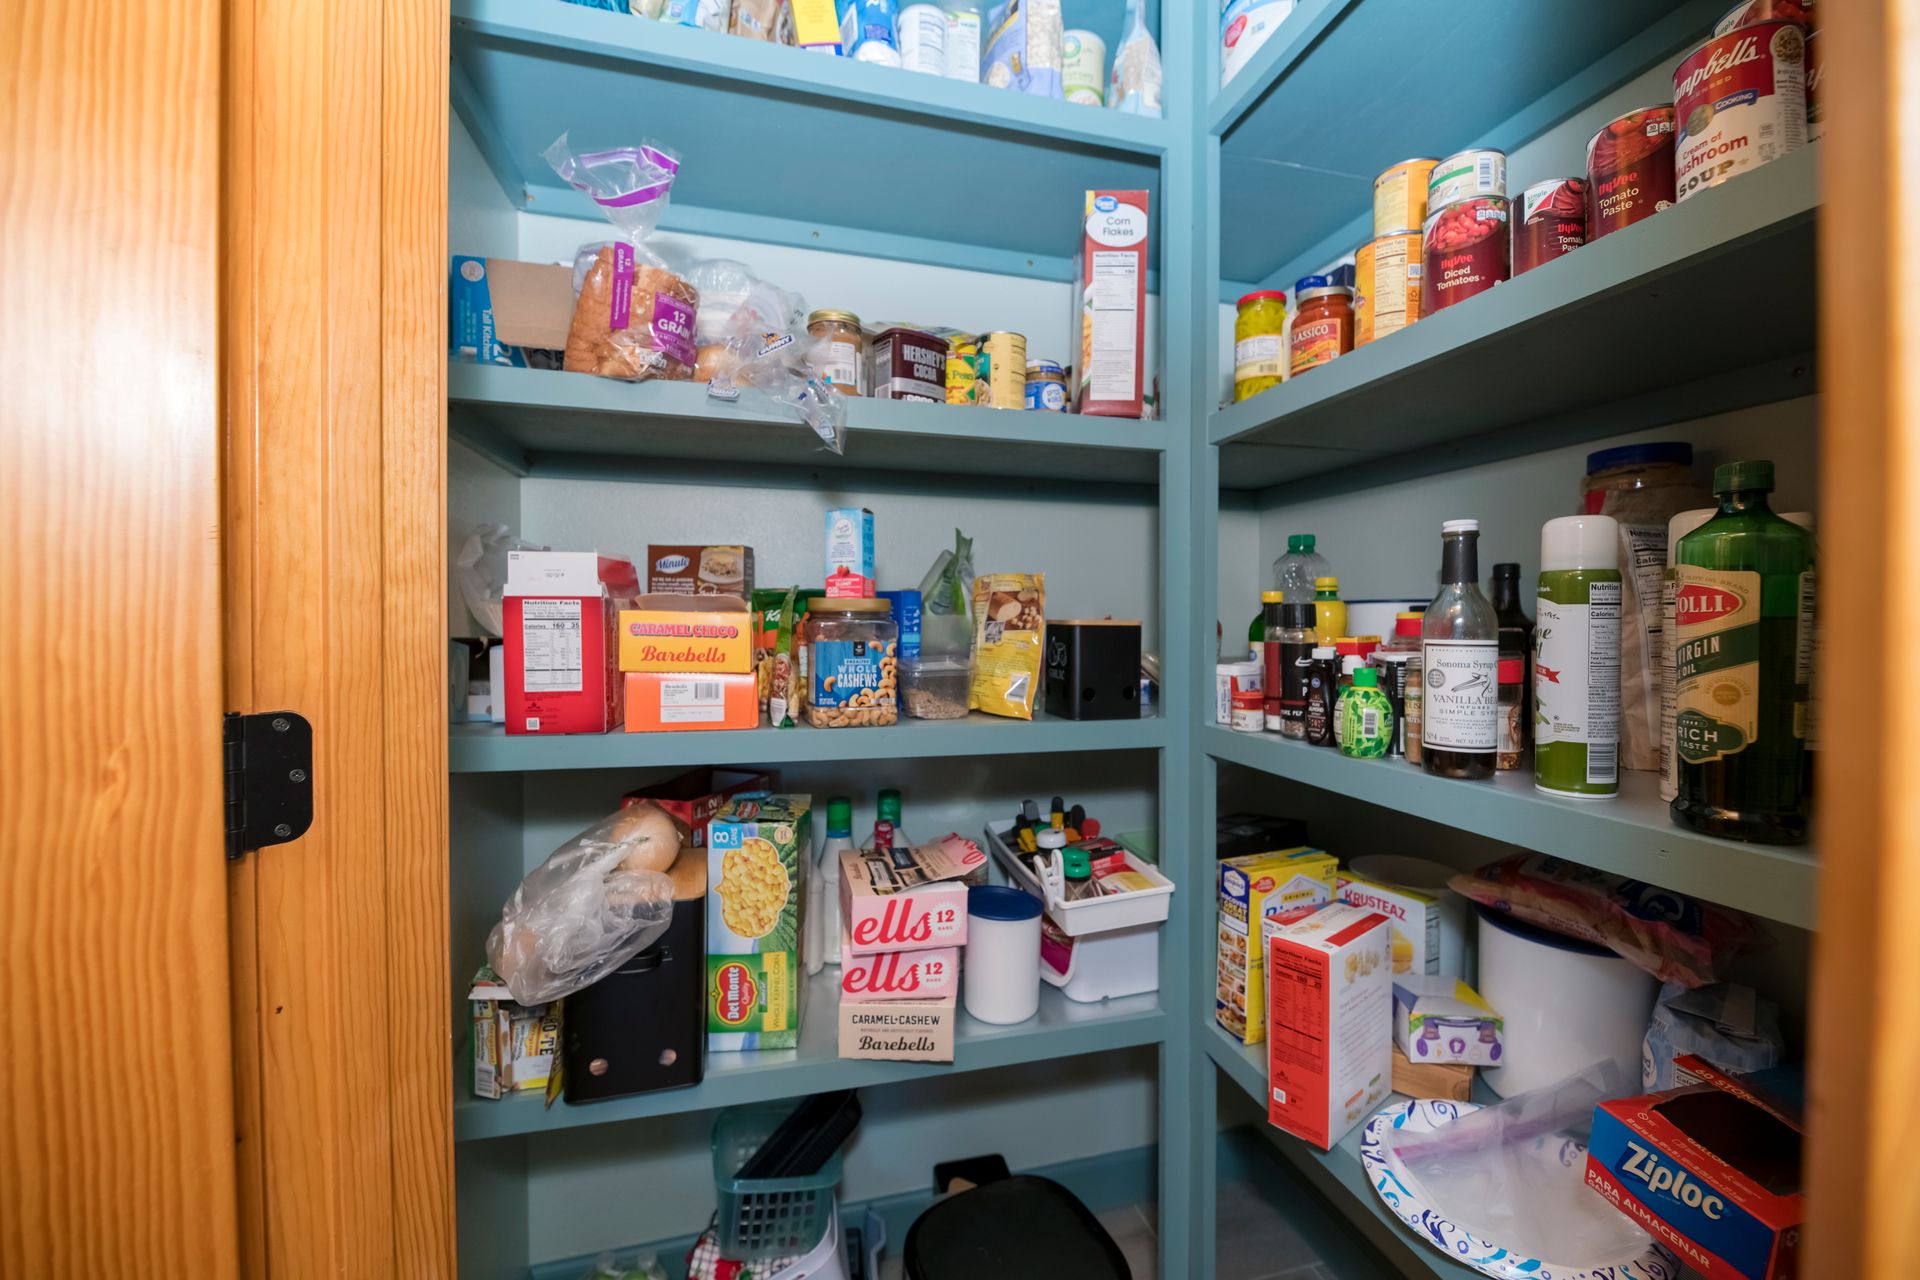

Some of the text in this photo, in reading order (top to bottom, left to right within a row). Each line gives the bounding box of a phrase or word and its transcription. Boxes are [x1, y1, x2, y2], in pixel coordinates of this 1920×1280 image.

[1674, 36, 1761, 105] ampbell's
[1714, 92, 1754, 111] COOKING
[1682, 130, 1722, 160] Cream of
[1679, 159, 1736, 198] SOUP
[1599, 187, 1640, 210] Tomato
[1603, 201, 1634, 219] Paste
[1105, 216, 1131, 226] Corn
[1103, 227, 1134, 237] Flakes
[1444, 265, 1471, 280] Diced
[1437, 275, 1480, 292] Tomatoes
[673, 310, 687, 325] 12
[657, 318, 691, 339] GRAIN
[902, 344, 946, 370] HERSHEY'S
[913, 363, 937, 382] COCOA
[1591, 583, 1619, 591] Nutrition
[630, 622, 739, 638] CARAMEL CHOCO
[641, 645, 727, 663] Barebells
[1677, 635, 1721, 665] VIRGIN
[837, 665, 877, 673] WHOLE
[1436, 659, 1496, 672] Sonoma Syrup
[1682, 663, 1697, 677] OIL
[837, 674, 877, 688] CASHEWS
[1433, 694, 1483, 705] VANILLA
[1438, 708, 1477, 716] SIMPLE
[1677, 726, 1718, 742] RICH
[1680, 741, 1709, 751] TASTE
[708, 798, 717, 816] 12
[713, 832, 730, 843] 8
[730, 827, 738, 846] CANS
[1283, 891, 1313, 901] ORIGINAL
[1343, 888, 1407, 922] KRUSTEAZ
[853, 898, 932, 946] ells
[936, 909, 954, 923] 12
[841, 952, 921, 994] ells
[924, 962, 943, 976] 12
[727, 966, 740, 1020] Del Monte
[858, 1035, 935, 1052] Barebells
[1695, 1068, 1714, 1080] 60
[1622, 1141, 1724, 1220] Ziploc
[1588, 1169, 1711, 1270] PARA ALMACENAR
